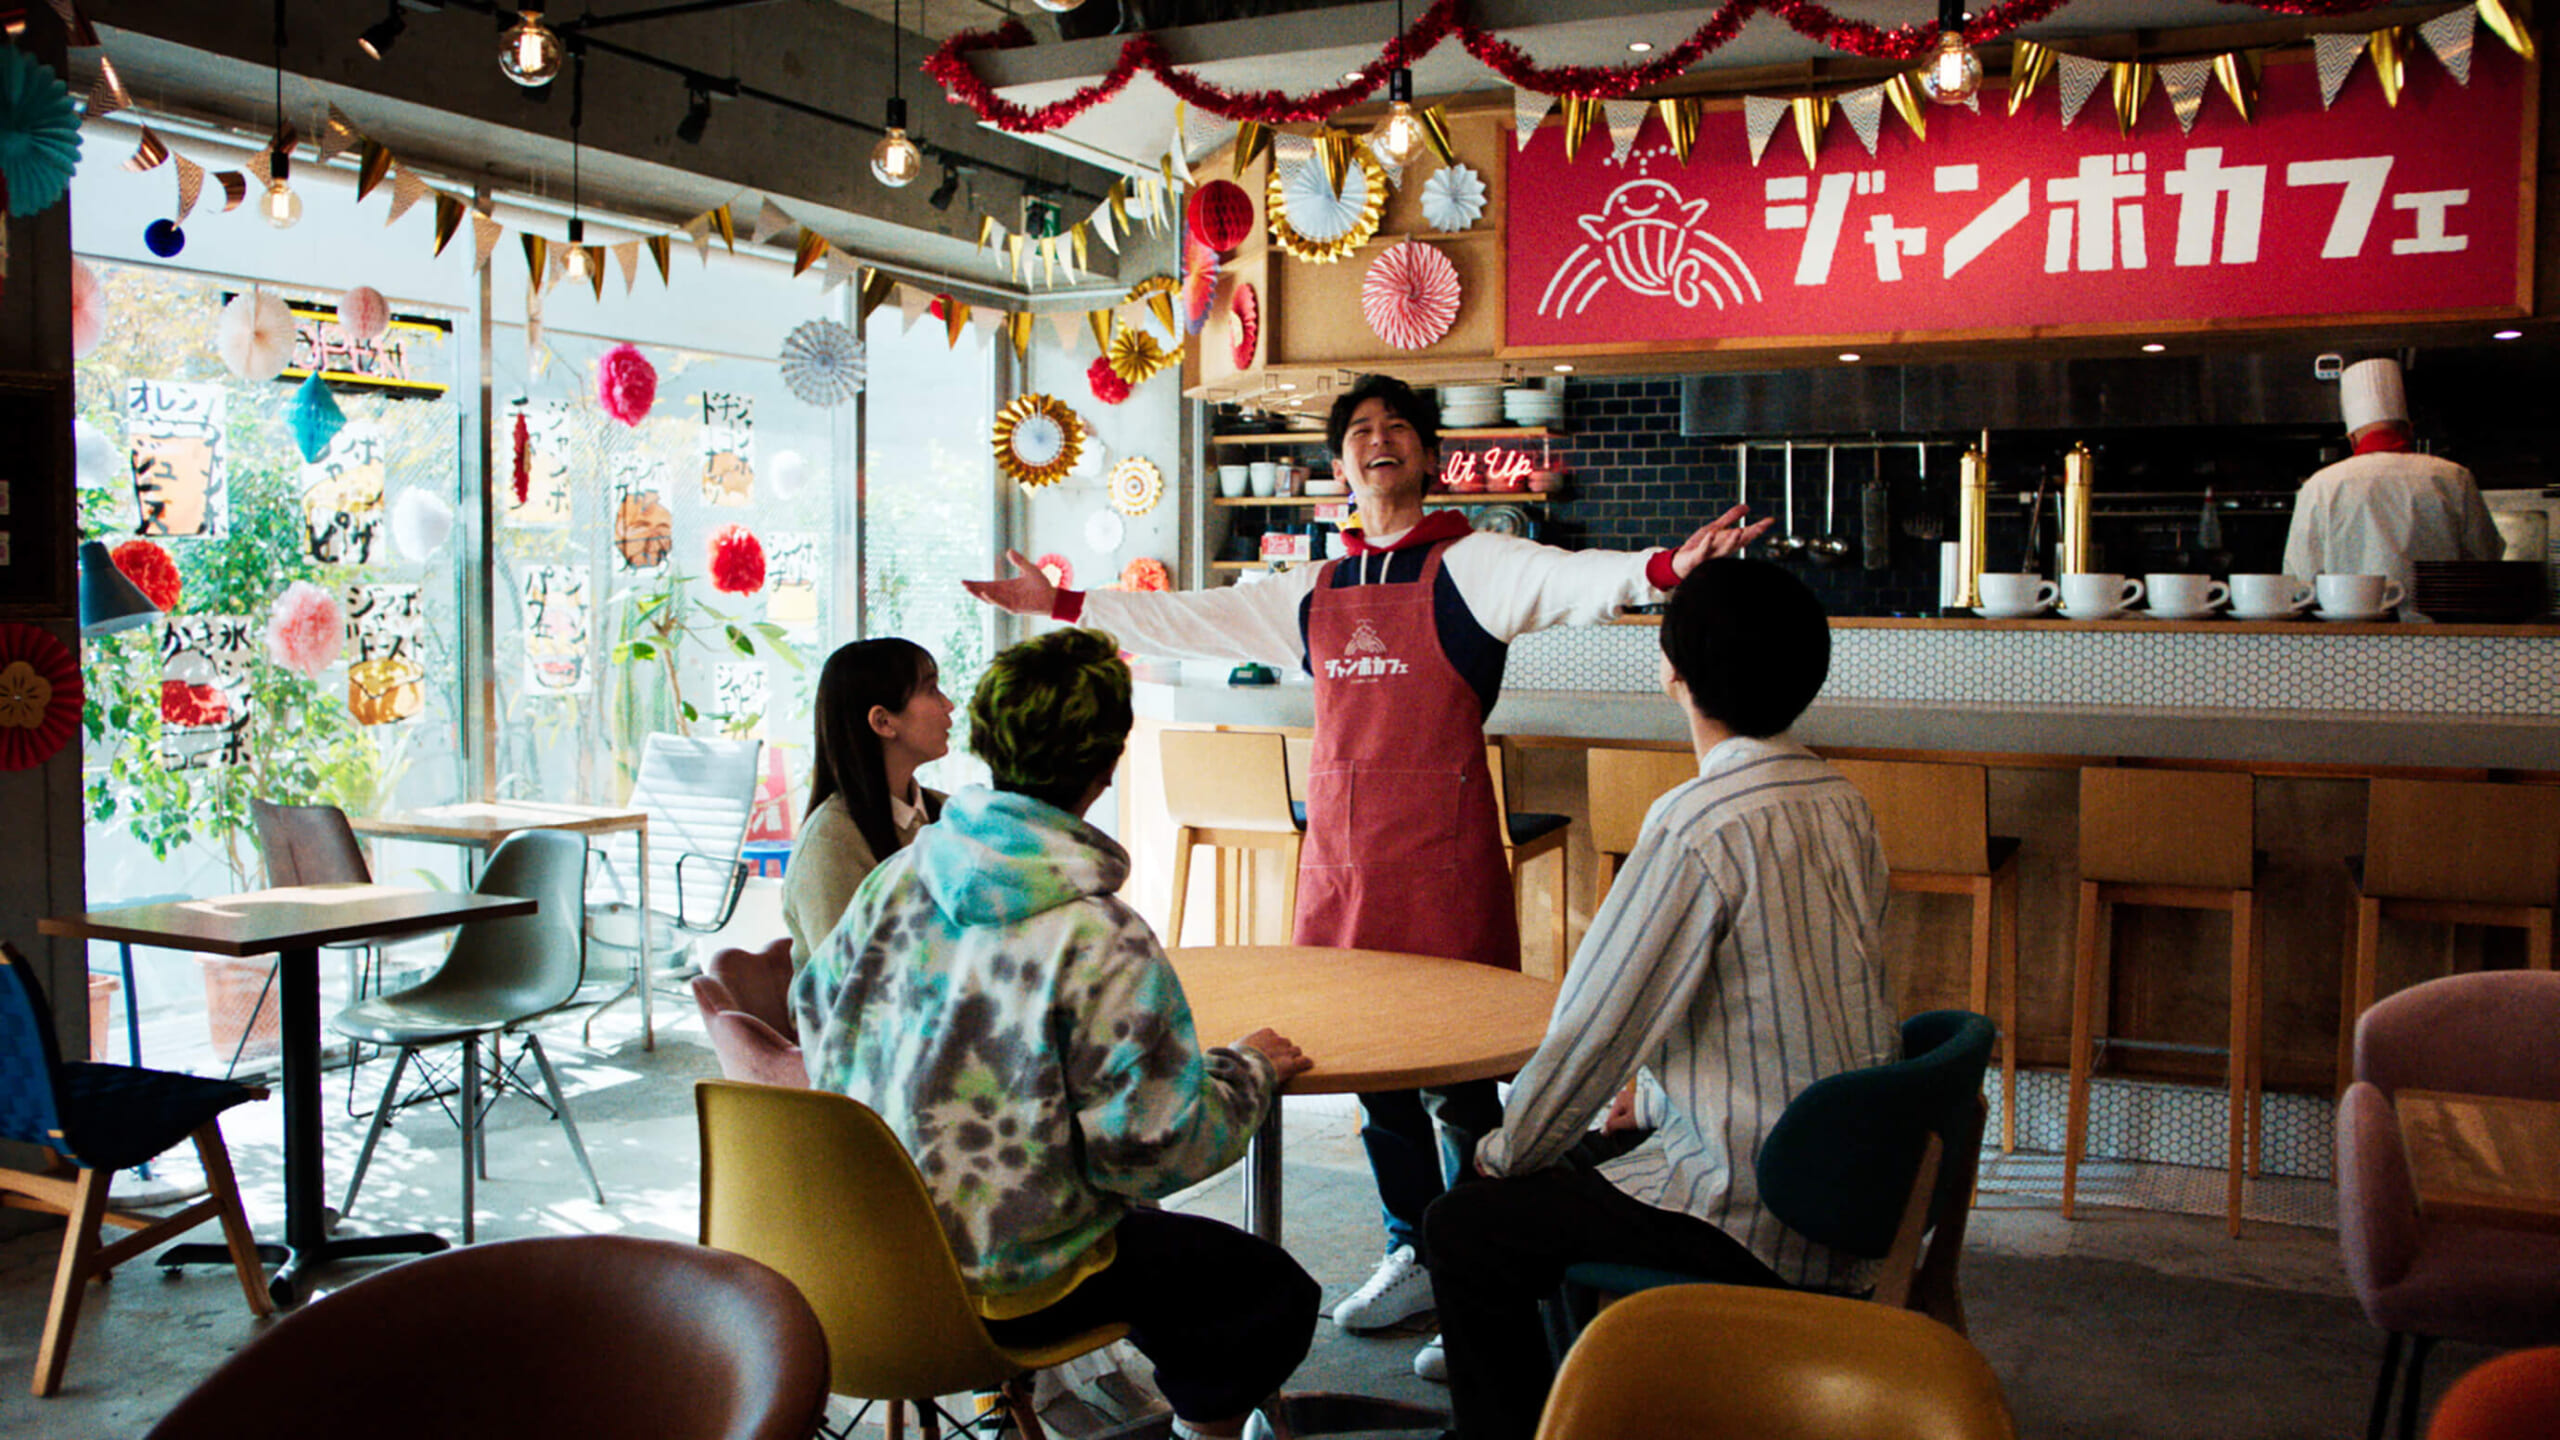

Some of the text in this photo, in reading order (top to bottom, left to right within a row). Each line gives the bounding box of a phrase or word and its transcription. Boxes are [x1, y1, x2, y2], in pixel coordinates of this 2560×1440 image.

[1765, 147, 2469, 284] ジャンボカフェ
[1484, 447, 1533, 488] Up
[525, 565, 556, 640] パフェ
[162, 620, 252, 668] かき氷
